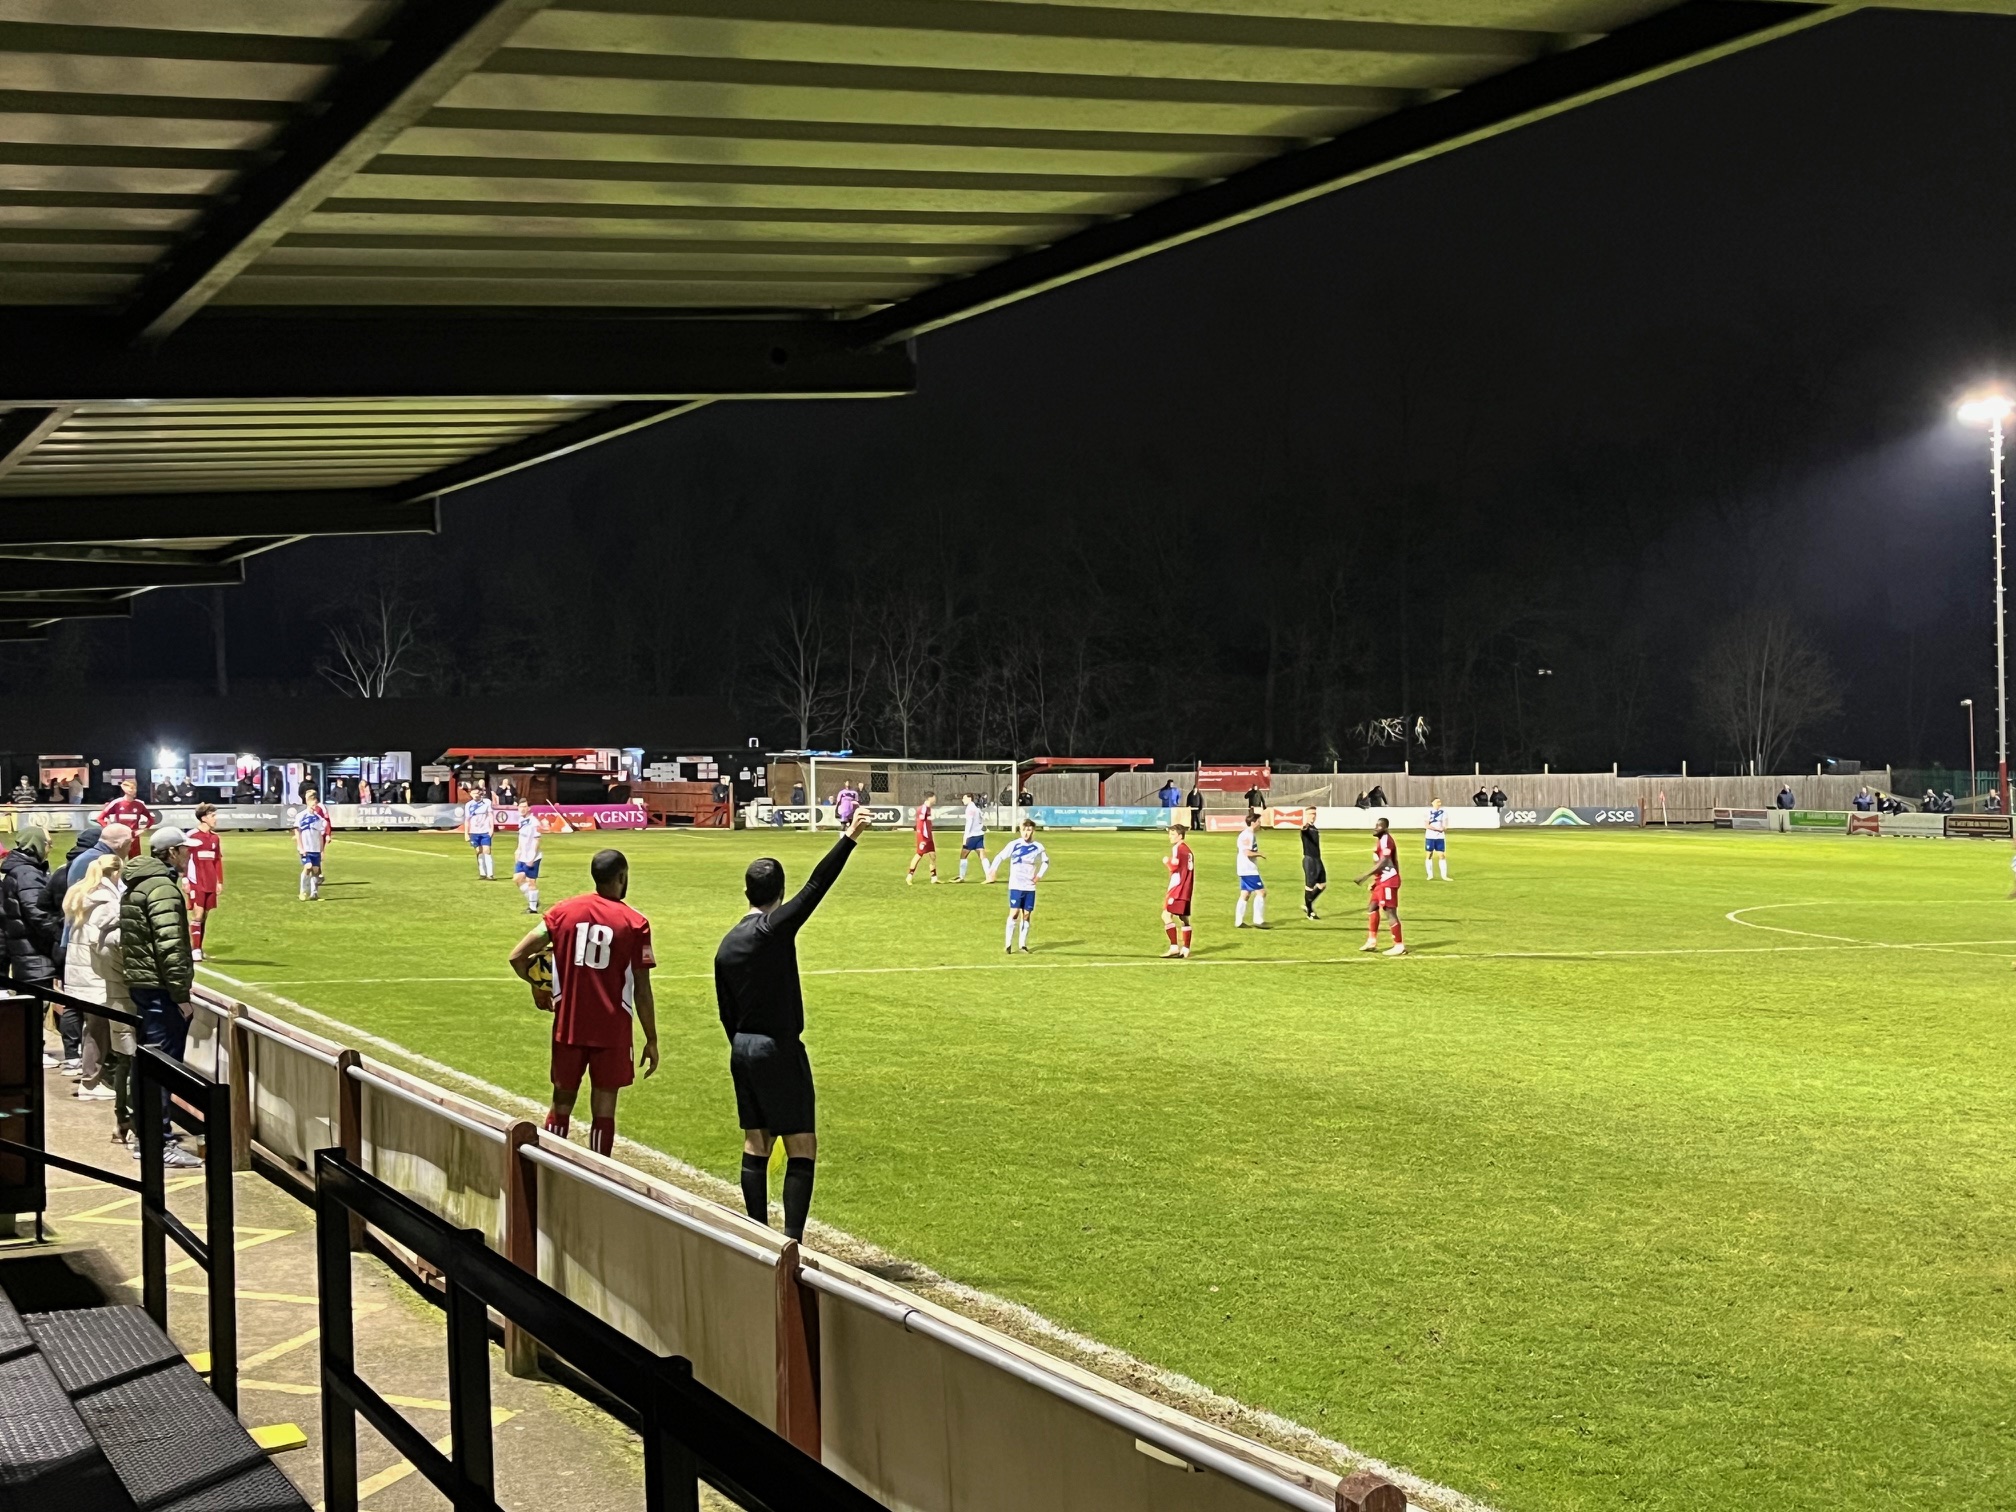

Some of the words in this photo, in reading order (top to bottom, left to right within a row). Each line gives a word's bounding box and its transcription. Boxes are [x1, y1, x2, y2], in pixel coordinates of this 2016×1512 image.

[593, 811, 644, 824] AGENTS
[1514, 811, 1537, 823] sse
[1607, 810, 1635, 823] sse
[574, 922, 613, 969] 18
